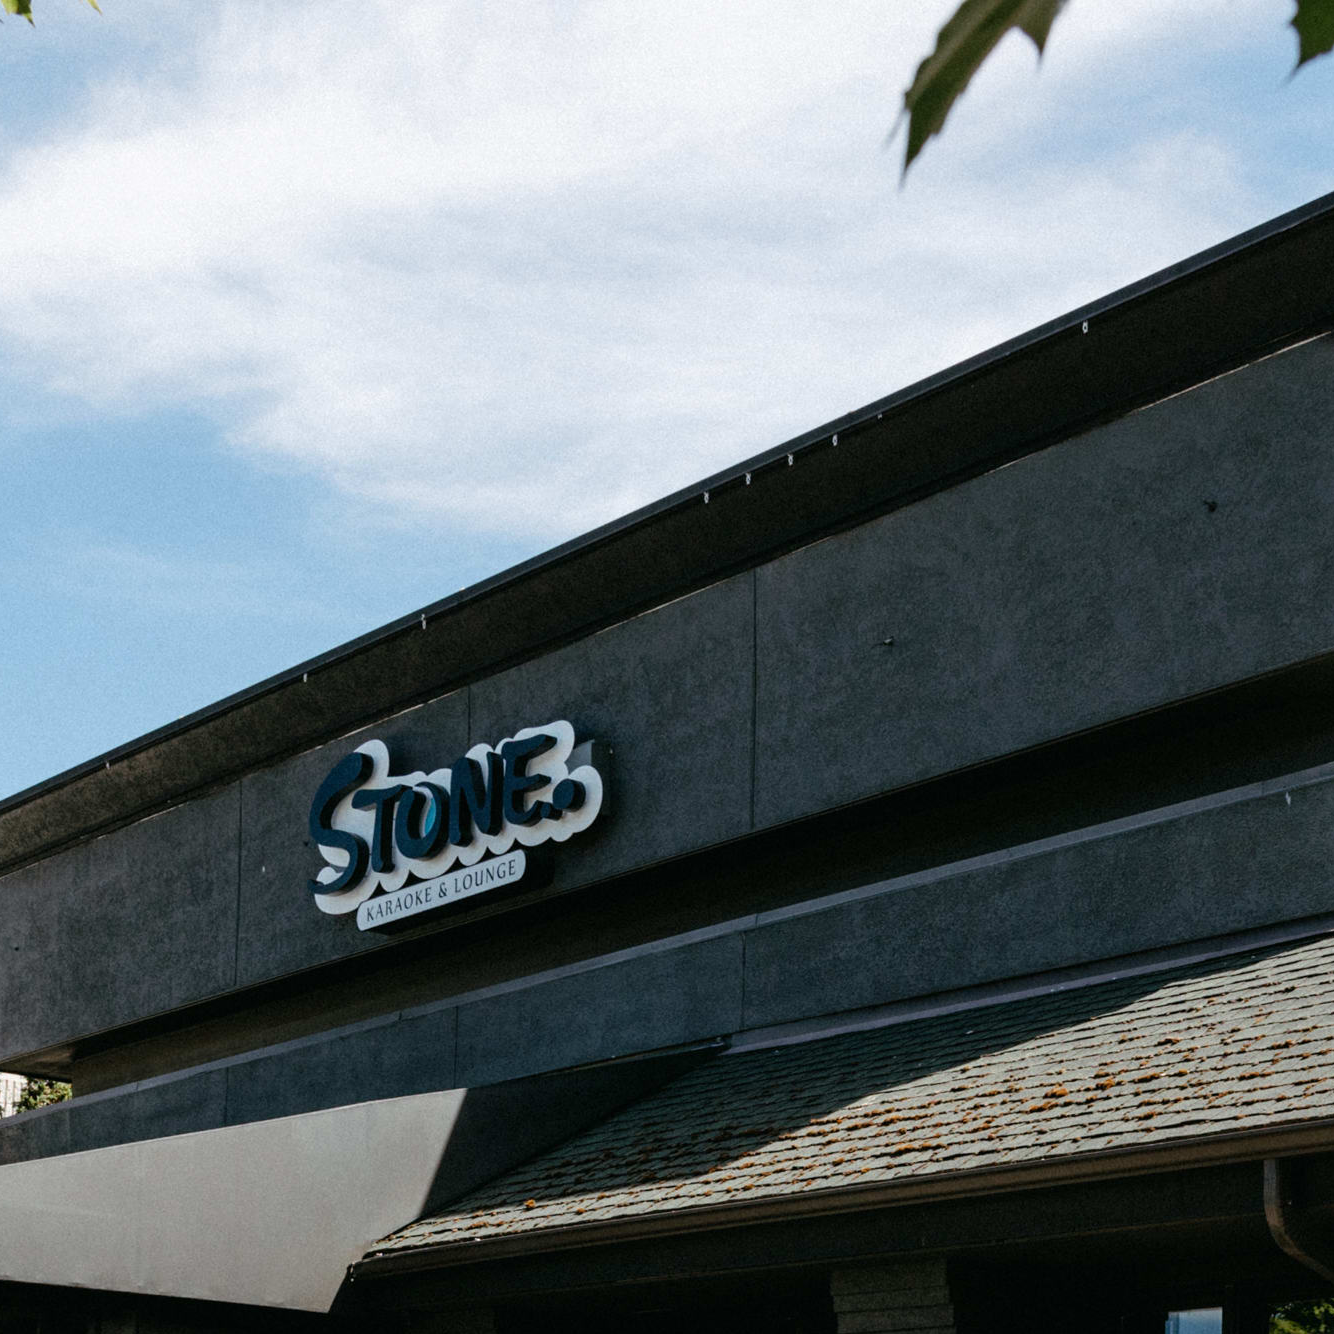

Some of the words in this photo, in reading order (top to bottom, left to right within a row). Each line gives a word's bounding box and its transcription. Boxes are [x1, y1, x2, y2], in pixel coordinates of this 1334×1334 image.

[308, 734, 559, 895] STONE
[366, 886, 432, 922] KARAOKE
[438, 882, 448, 899] &
[454, 859, 517, 894] LOUNGE
